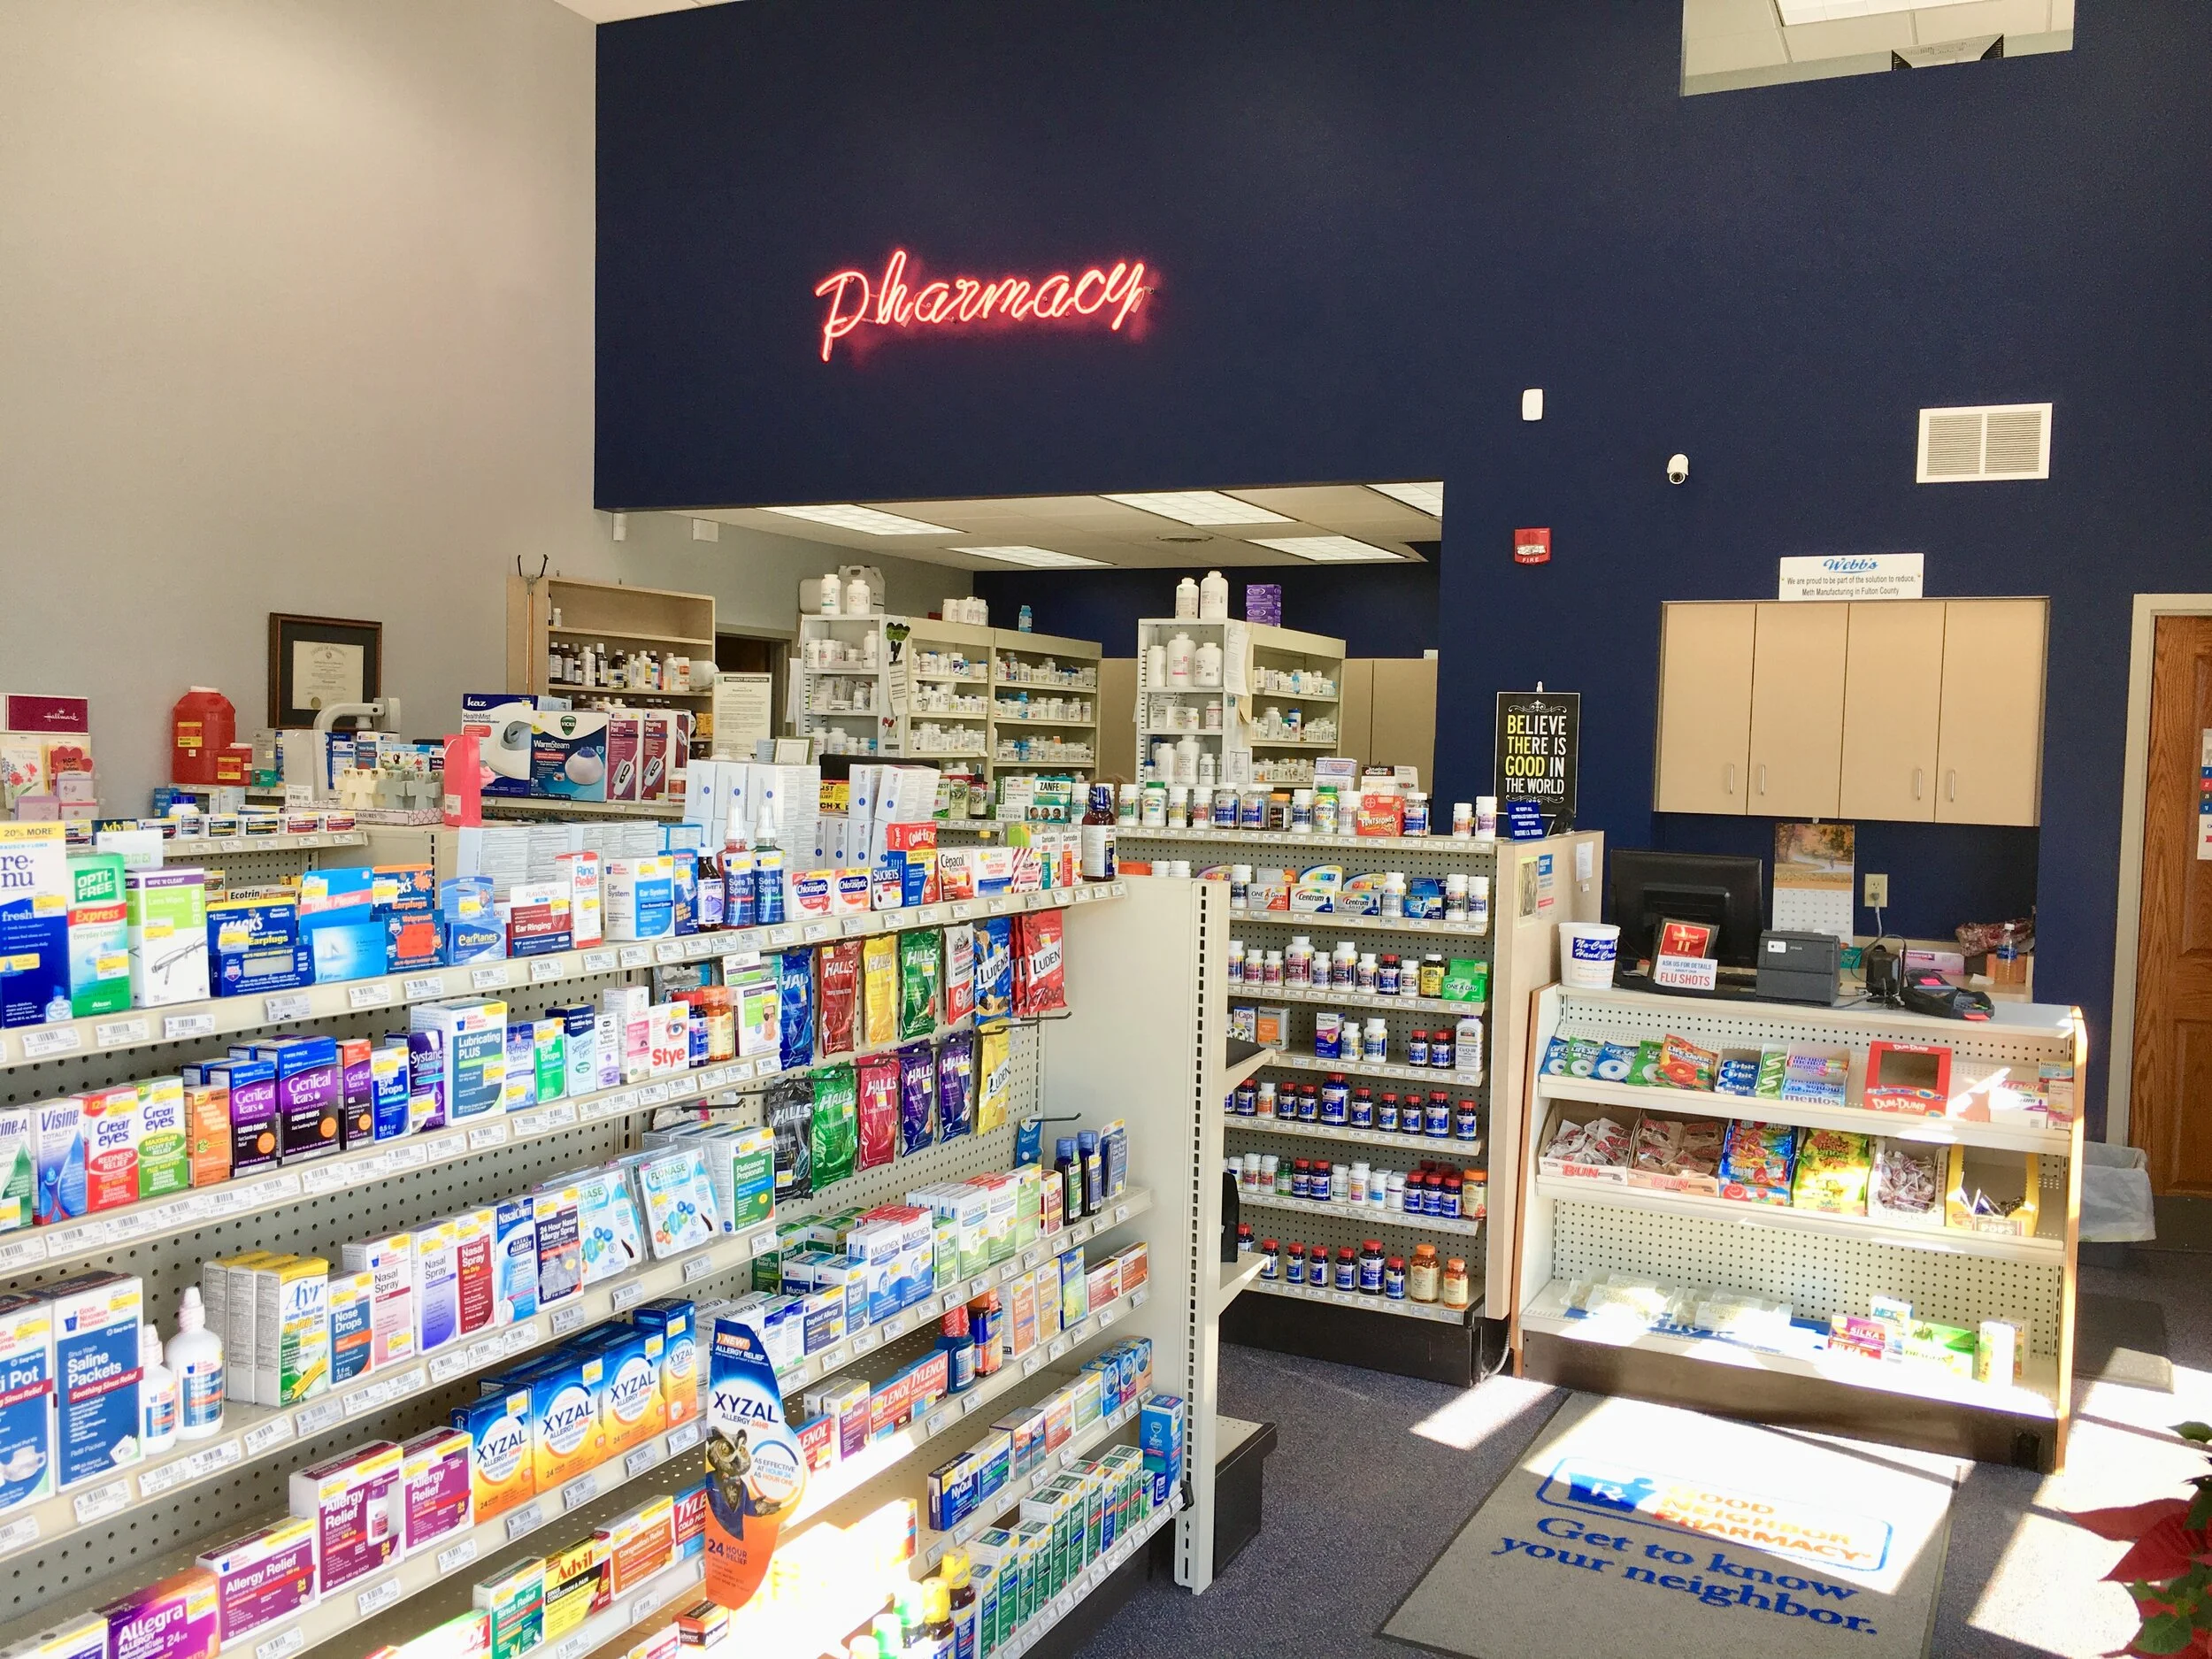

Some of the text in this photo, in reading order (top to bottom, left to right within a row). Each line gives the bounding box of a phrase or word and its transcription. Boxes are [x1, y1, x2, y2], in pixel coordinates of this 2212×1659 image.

[1824, 558, 1878, 571] Webb's
[1816, 588, 1854, 596] Manufacturing
[1880, 587, 1899, 595] County
[467, 696, 487, 707] kaz
[43, 711, 79, 722] Hallmark
[1508, 715, 1566, 734] BELIEVE
[534, 741, 570, 749] WarmSteam
[1508, 736, 1566, 755] THERE IS
[1506, 756, 1564, 777] GOOD IN
[1506, 778, 1564, 794] THE WORLD
[78, 870, 111, 887] OPTI-
[576, 866, 595, 876] Ring
[873, 869, 899, 881] SUCRETS
[575, 876, 597, 887] Relief
[758, 877, 775, 886] Sore
[796, 883, 828, 895] Chloraseptic
[79, 881, 113, 900] FREE
[230, 890, 259, 900] Ecotrin
[392, 901, 427, 910] Earplugs
[2, 910, 33, 921] fresh
[75, 909, 119, 923] Express
[249, 934, 288, 946] Earplugs
[1576, 939, 1614, 950] No-Crack
[1575, 949, 1600, 959] Hand
[824, 960, 854, 978] HALLS
[1660, 972, 1709, 987] FLU SHOTS
[458, 1033, 501, 1048] Lubricating
[411, 1049, 442, 1068] Systane
[458, 1047, 480, 1060] PLUS
[652, 1048, 685, 1068] Stye
[288, 1071, 331, 1094] GenTeal
[865, 1077, 897, 1097] HALLS
[235, 1087, 273, 1104] GenTeal
[291, 1092, 313, 1104] Tears
[379, 1085, 403, 1096] Drops
[1784, 1094, 1839, 1106] mentos
[41, 1109, 80, 1132] Visine
[772, 1103, 812, 1126] HALLS
[145, 1117, 174, 1133] eyes
[238, 1125, 252, 1134] LIQUID
[42, 1130, 73, 1140] TOTALITY
[98, 1131, 128, 1148] eyes
[98, 1151, 134, 1164] REDNESS
[104, 1158, 128, 1170] RELIEF
[650, 1163, 687, 1181] FLONASE
[736, 1159, 765, 1174] Fluticasone
[736, 1166, 764, 1180] Propionate
[1563, 1164, 1600, 1179] BUN
[1651, 1177, 1690, 1190] BUN
[498, 1207, 532, 1225] NasalCrom
[540, 1217, 577, 1235] 24 Hour Nasal
[902, 1225, 930, 1241] Mucinex
[1980, 1223, 2016, 1236] POPS
[462, 1242, 484, 1256] Nasal
[871, 1239, 899, 1256] Mucinex
[425, 1256, 446, 1270] Nasal
[462, 1254, 485, 1268] Spray
[375, 1269, 398, 1282] Nasal
[425, 1265, 447, 1280] Spray
[374, 1279, 399, 1294] Spray
[786, 1286, 806, 1295] Mucus
[286, 1279, 324, 1310] Ayr
[80, 1306, 96, 1315] GOOD
[335, 1309, 357, 1323] Nose
[335, 1317, 362, 1333] Drops
[724, 1335, 747, 1347] NEW!
[715, 1345, 742, 1356] ALLERGY
[743, 1350, 764, 1361] RELIEF
[68, 1351, 109, 1373] Saline
[11, 1366, 39, 1390] Pot
[68, 1362, 122, 1389] Packets
[911, 1357, 947, 1388] TYLENOL
[73, 1371, 137, 1400] Soothing Sinus Relief
[611, 1371, 656, 1402] XYZAL
[4, 1385, 43, 1404] Sinus Relief
[714, 1391, 773, 1423] XYZAL
[543, 1401, 594, 1434] XYZAL
[721, 1412, 750, 1425] ALLERGY
[476, 1430, 527, 1463] XYZAL
[763, 1459, 795, 1472] EFFECTIVE
[765, 1467, 782, 1476] HOUR
[783, 1471, 792, 1479] 24
[411, 1469, 445, 1491] Allergy
[763, 1472, 780, 1483] HOUR
[781, 1476, 794, 1486] ONE
[412, 1483, 439, 1503] Relief
[951, 1479, 973, 1500] NyQuil
[325, 1489, 365, 1515] Allergy
[326, 1507, 358, 1531] Relief
[679, 1518, 694, 1532] COLD
[619, 1529, 664, 1558] Congestion Relief
[708, 1538, 747, 1558] 24 HOUR
[726, 1553, 747, 1565] RELIEF
[1536, 1517, 1861, 1602] Get to know
[226, 1555, 296, 1594] Allergy Relief
[557, 1549, 593, 1585] Advil
[547, 1586, 561, 1598] SINUS
[1491, 1535, 1878, 1635] your neighbor.
[497, 1592, 536, 1620] Sinus Relief
[119, 1603, 184, 1646] Allegra
